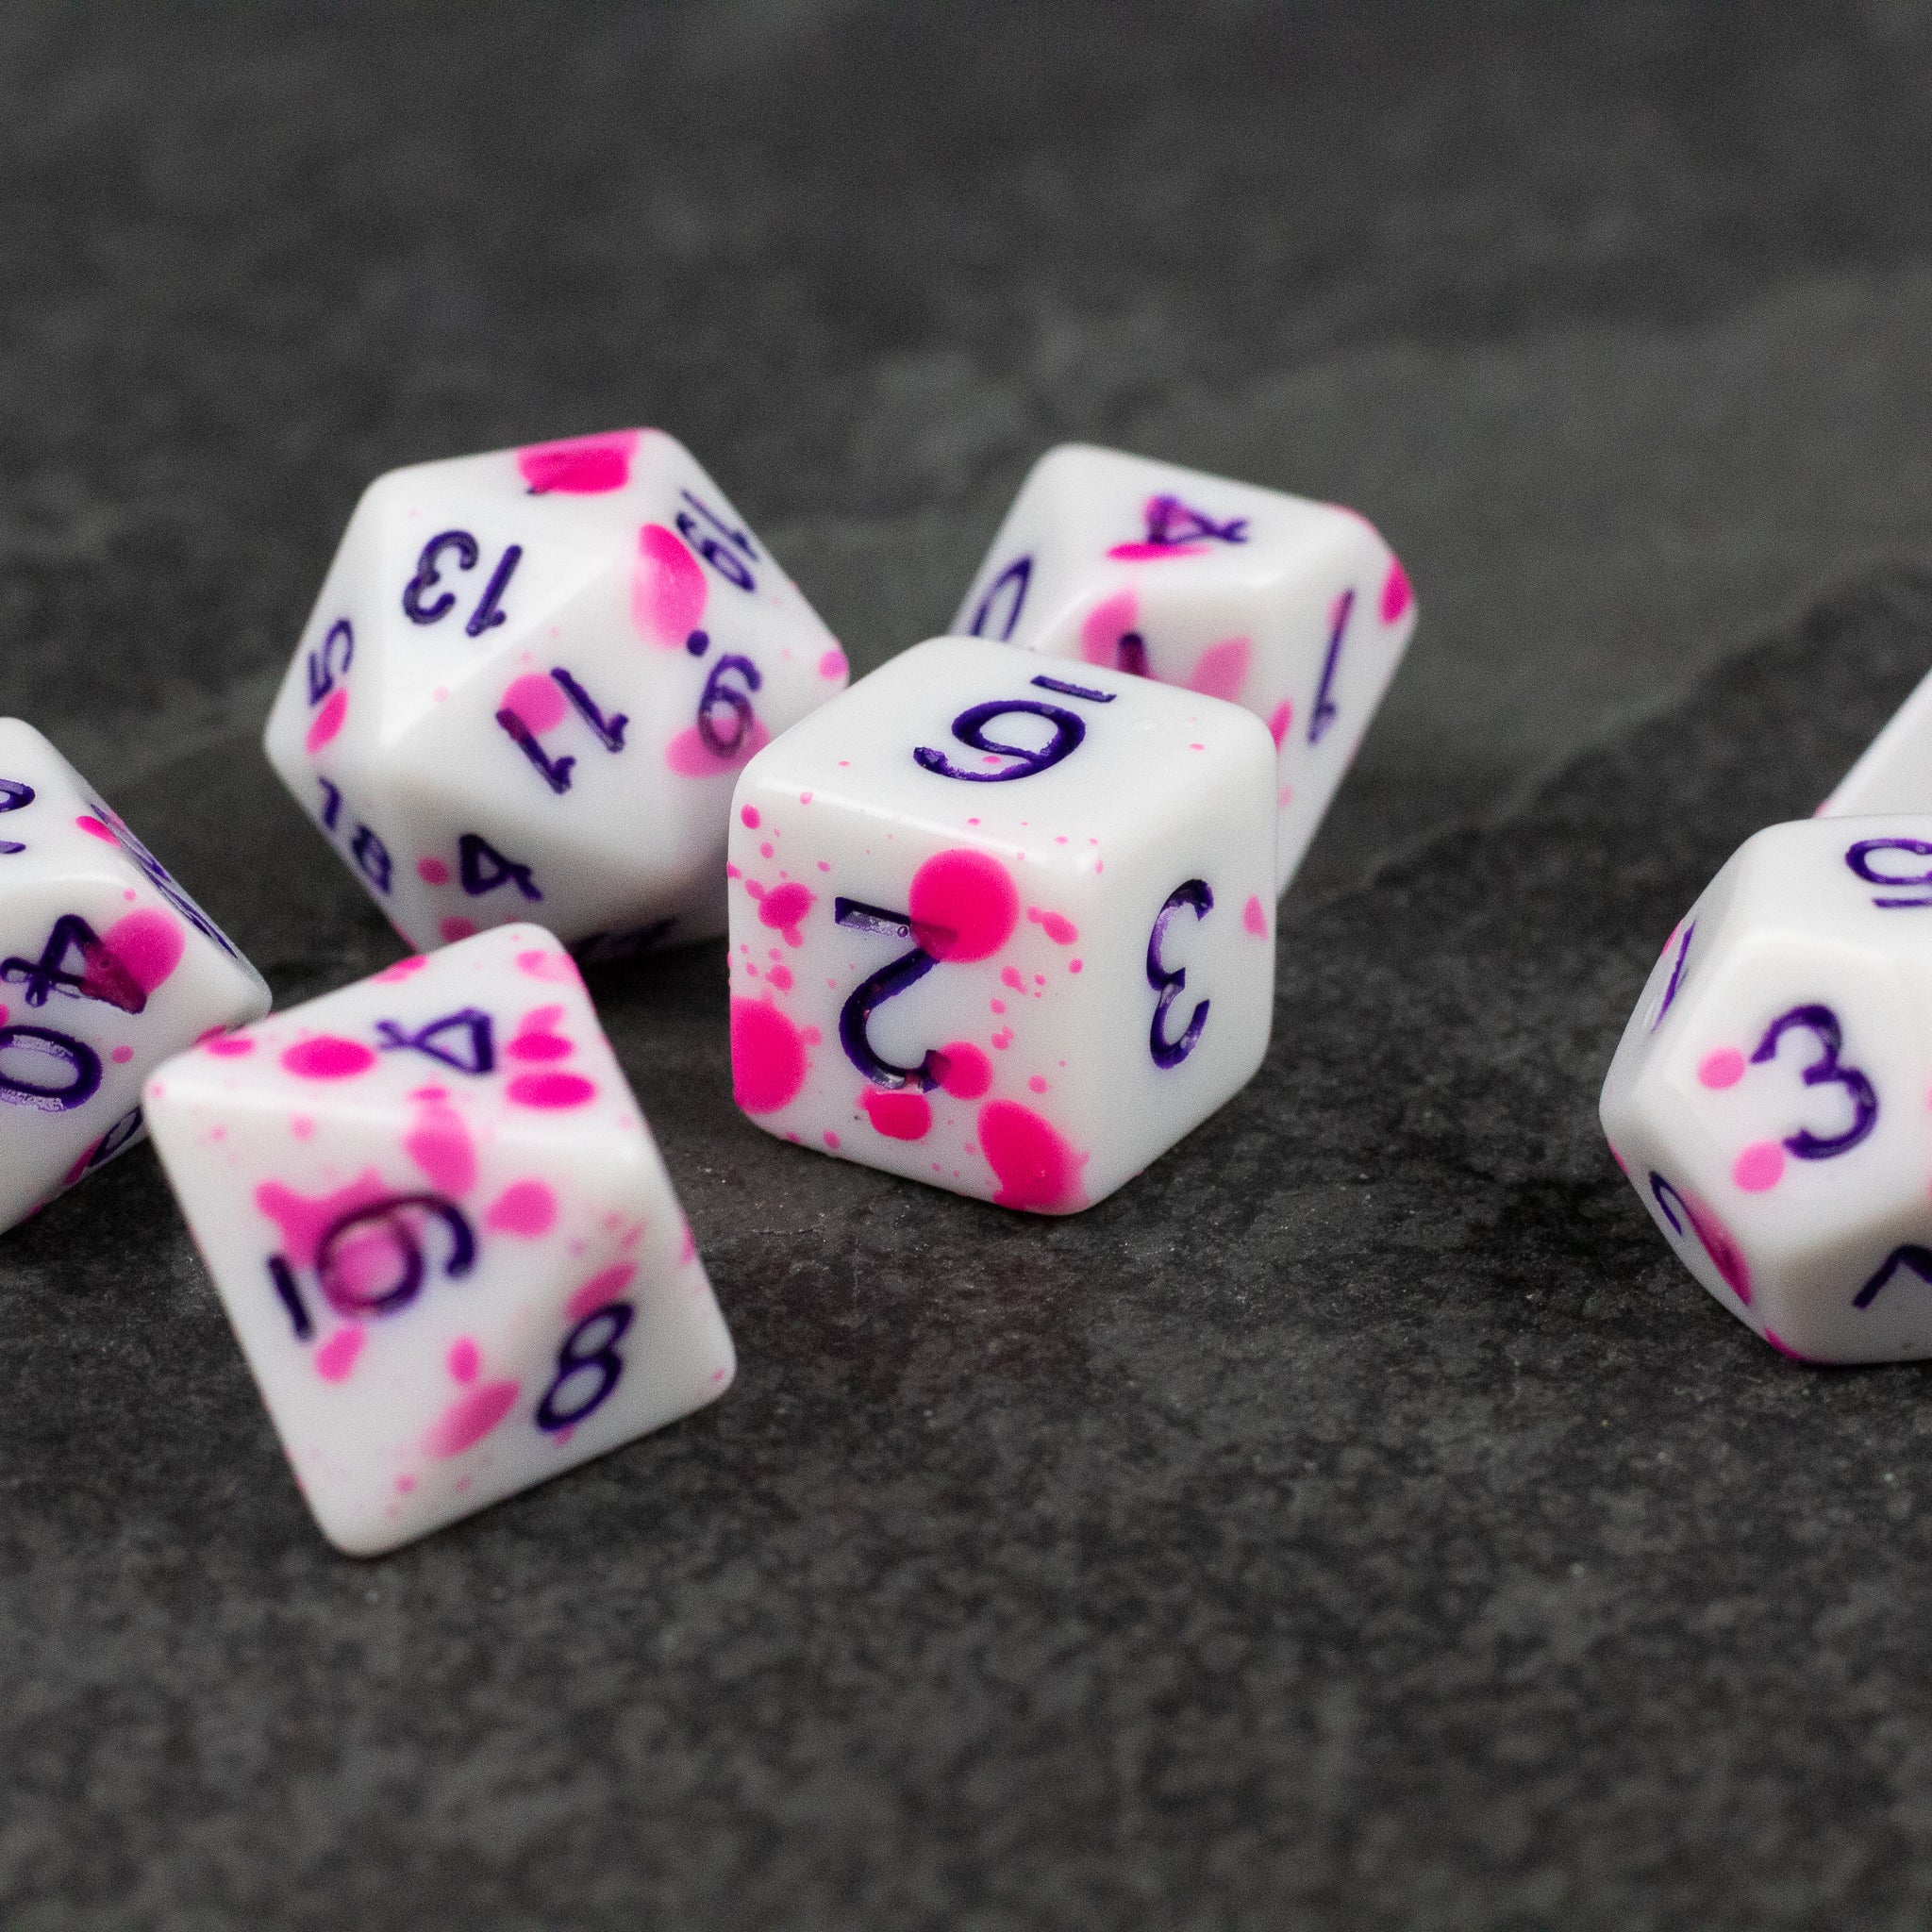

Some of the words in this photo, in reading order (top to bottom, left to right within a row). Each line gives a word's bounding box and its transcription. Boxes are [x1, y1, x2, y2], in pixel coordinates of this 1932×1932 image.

[1145, 495, 1247, 545] 4
[403, 530, 523, 637] 13
[307, 619, 353, 706] 5
[1307, 588, 1355, 747] 1
[495, 667, 629, 791] 11
[458, 834, 543, 901] 4
[834, 896, 955, 1091] 2
[1146, 878, 1214, 1071] 3
[375, 1008, 494, 1074] 4
[1752, 1004, 1877, 1159] 3
[535, 1302, 634, 1431] 8
